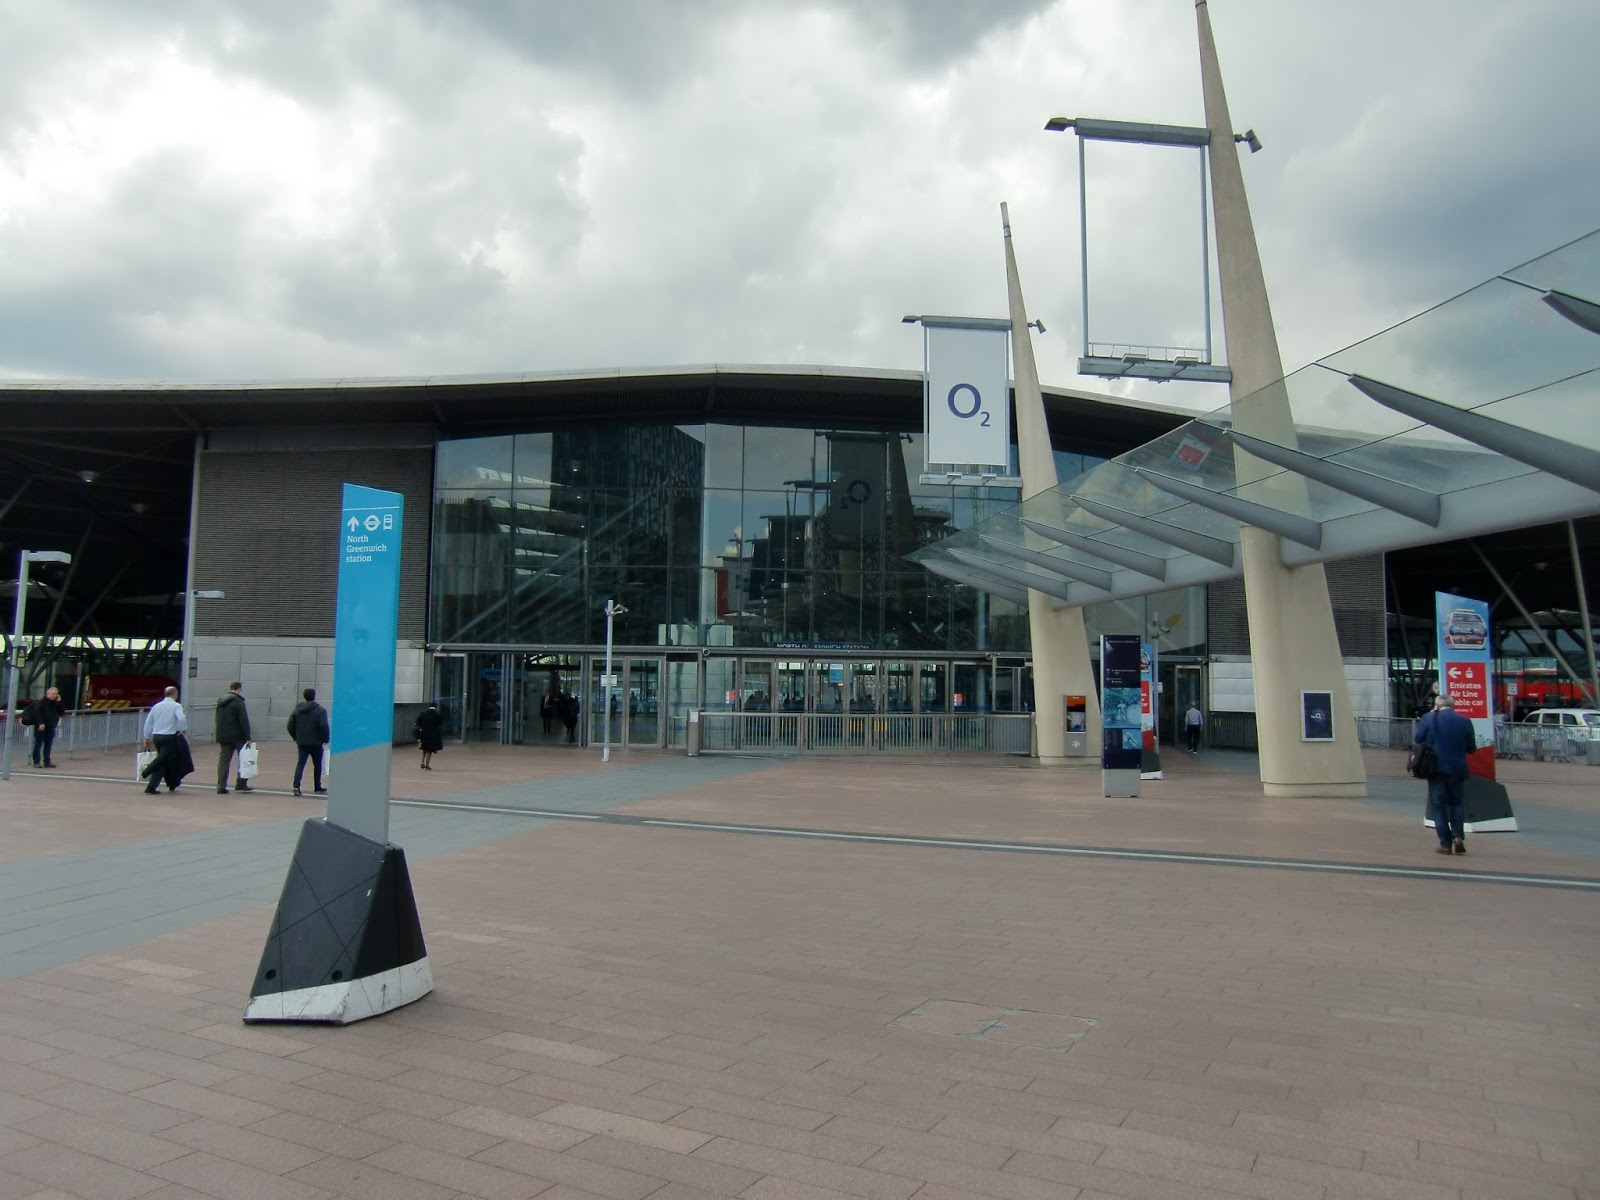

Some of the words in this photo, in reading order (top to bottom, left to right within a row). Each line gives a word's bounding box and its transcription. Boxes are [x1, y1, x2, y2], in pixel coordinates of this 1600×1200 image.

[947, 383, 991, 427] O2
[347, 535, 369, 543] North
[346, 544, 387, 553] Greenwich
[346, 555, 372, 563] station
